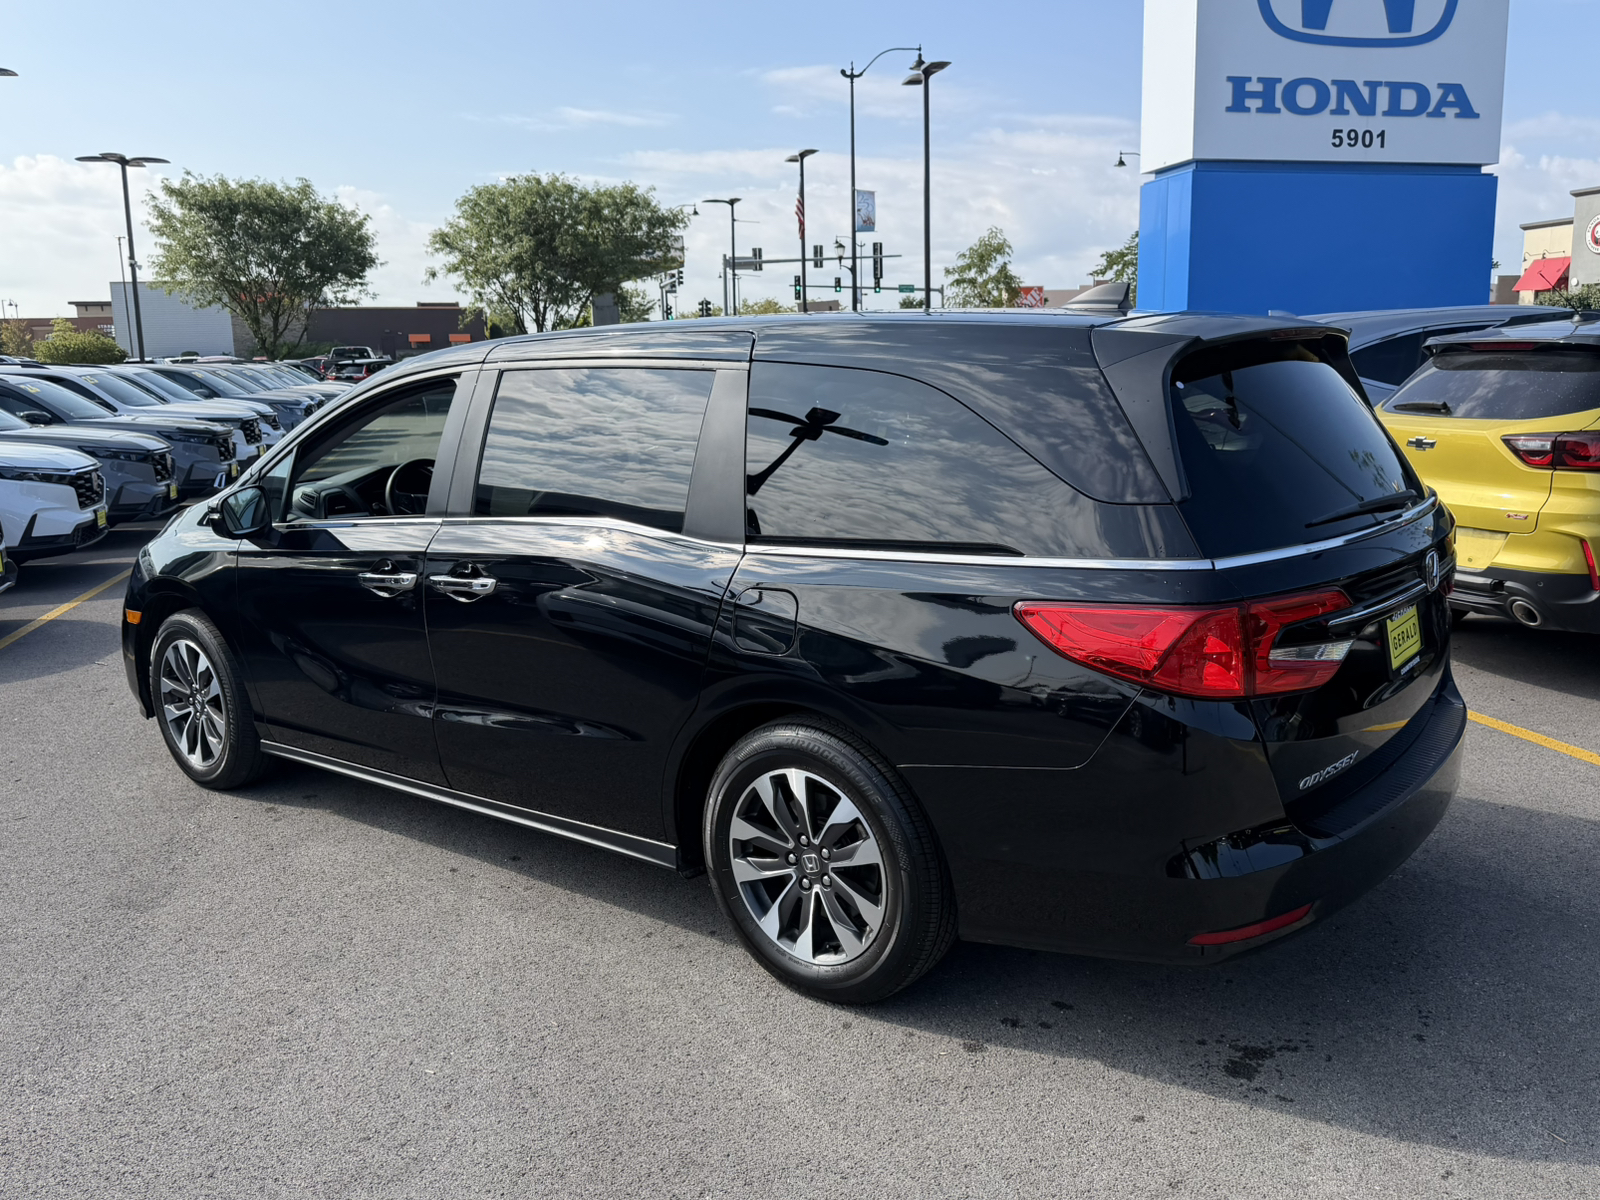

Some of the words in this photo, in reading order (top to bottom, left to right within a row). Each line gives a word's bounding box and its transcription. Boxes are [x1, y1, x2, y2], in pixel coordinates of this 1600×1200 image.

[1225, 76, 1480, 119] HONDA
[1331, 128, 1387, 149] 5901
[1392, 622, 1418, 651] GERALD
[1299, 750, 1359, 790] ODYSSEY
